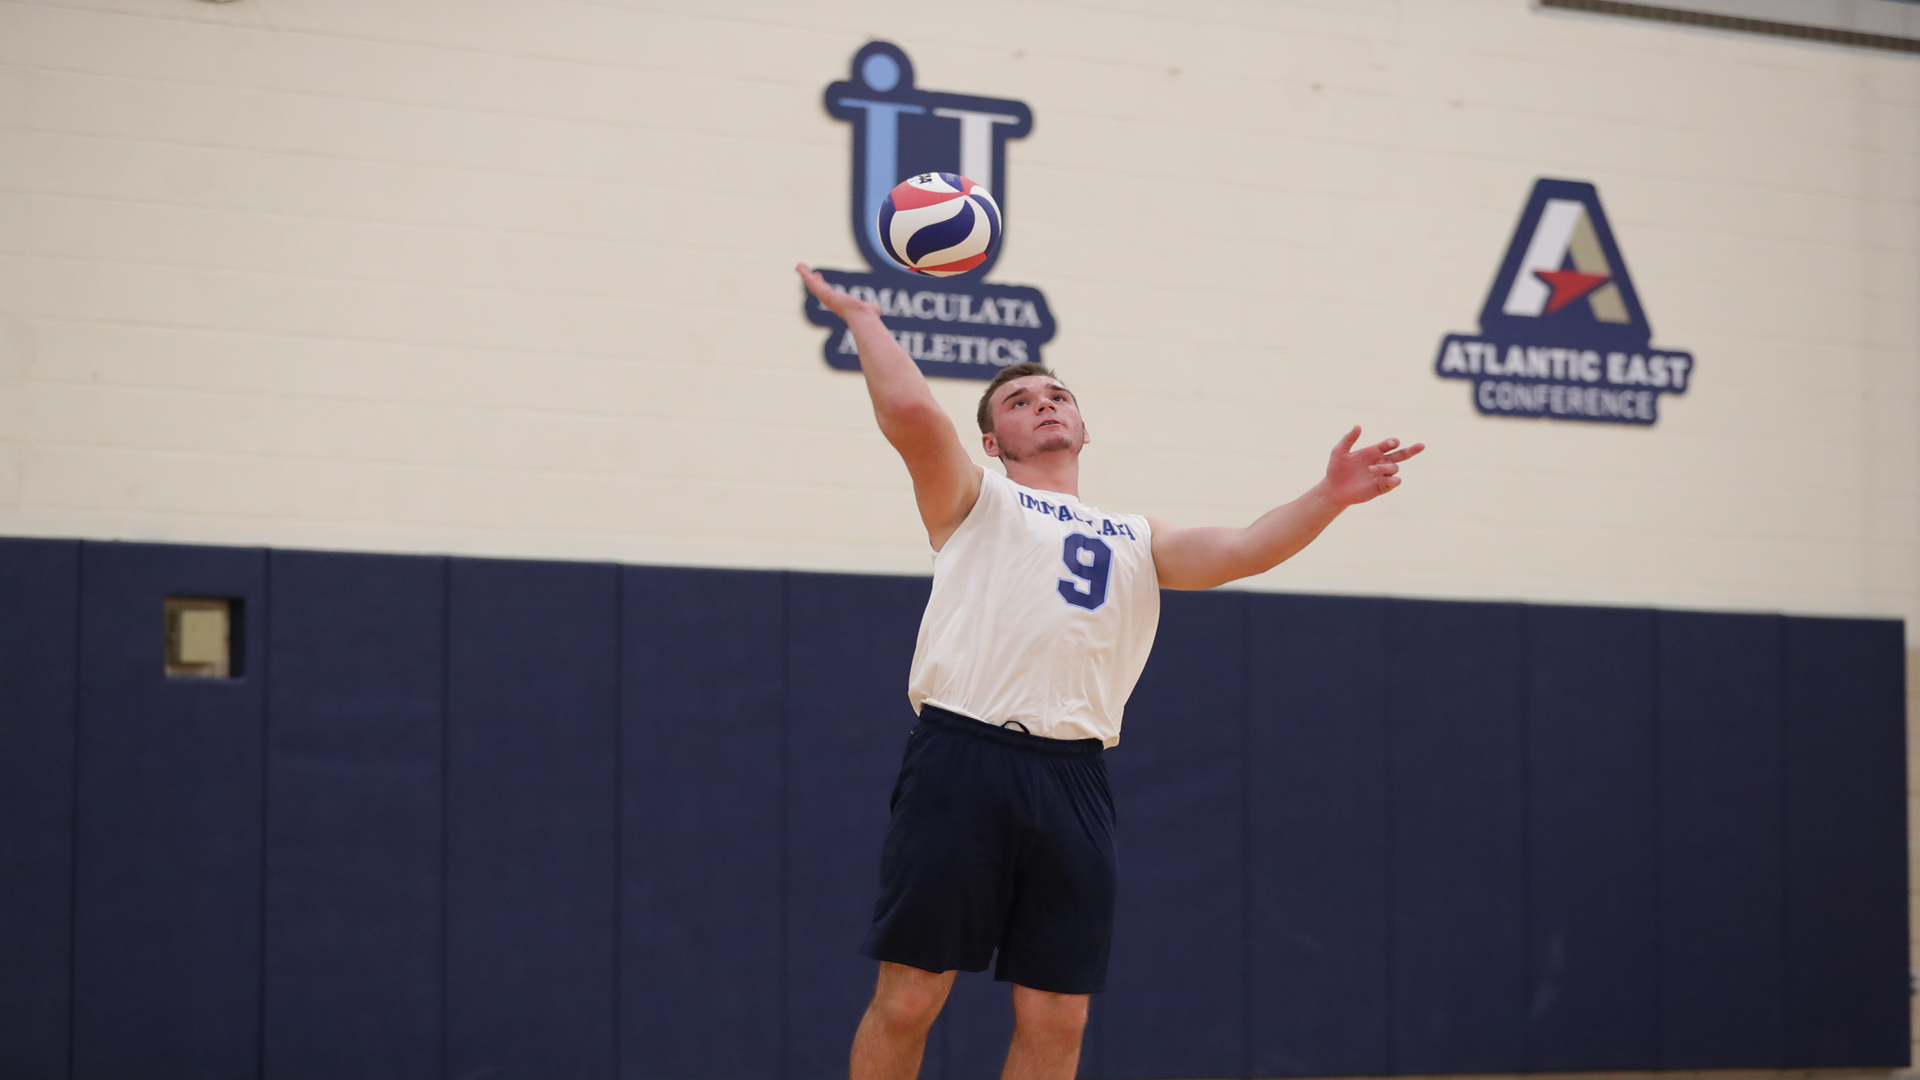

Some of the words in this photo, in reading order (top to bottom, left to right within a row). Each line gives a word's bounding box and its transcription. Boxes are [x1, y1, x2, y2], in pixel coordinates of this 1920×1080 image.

[838, 328, 1028, 366] AHLETICS
[1441, 340, 1602, 383] ATLANTIC
[1606, 351, 1689, 389] EAST
[1478, 380, 1653, 420] CONFERENCE
[1056, 531, 1114, 612] 9
